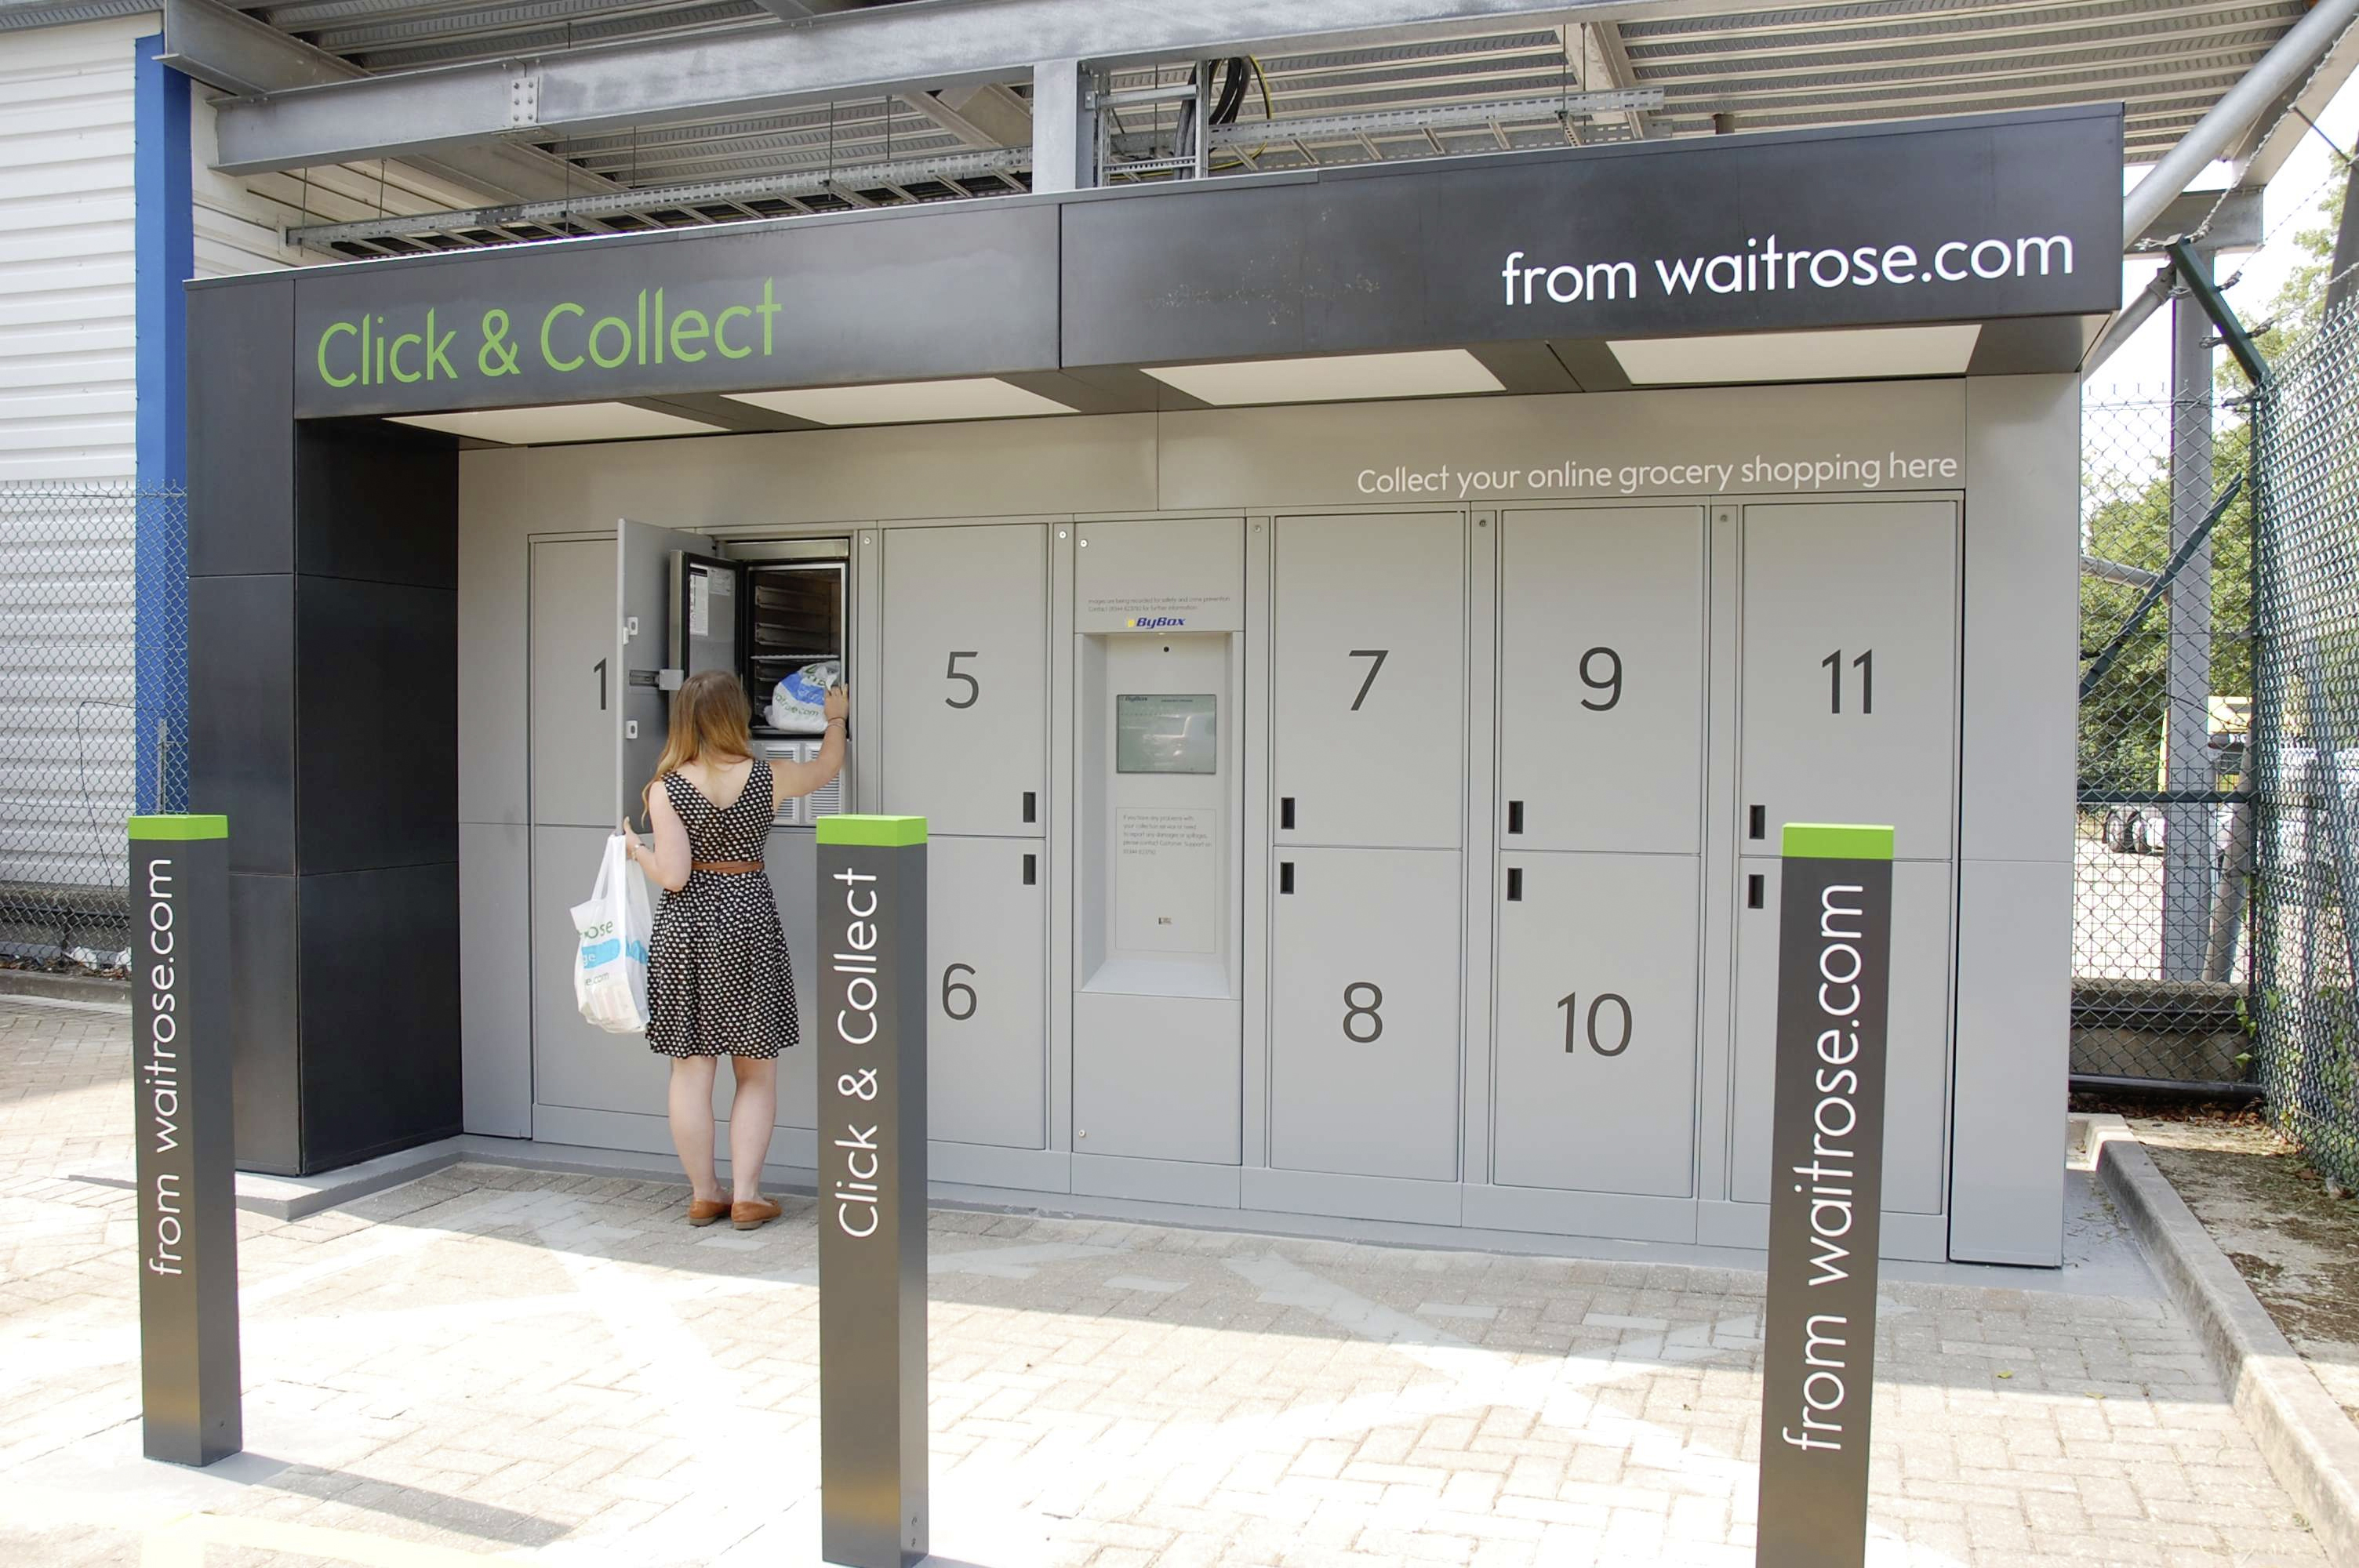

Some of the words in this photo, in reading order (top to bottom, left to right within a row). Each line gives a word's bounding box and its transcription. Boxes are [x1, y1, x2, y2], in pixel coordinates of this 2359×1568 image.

[1502, 251, 1637, 306] from
[1655, 234, 2073, 296] waitrose.com
[317, 307, 458, 388] Click
[478, 308, 521, 377] &
[540, 276, 783, 372] Collect
[1358, 464, 1449, 493] Collect
[1457, 470, 1520, 499] your
[1528, 461, 1612, 488] online
[1619, 463, 1733, 494] grocery
[1741, 454, 1881, 490] shopping
[1890, 452, 1957, 478] here
[1136, 617, 1186, 630] ByBox
[594, 658, 607, 710] 1
[945, 651, 980, 710] 5
[1348, 649, 1389, 711] 7
[1579, 646, 1623, 712] 9
[1822, 648, 1873, 714] 11
[833, 867, 878, 1044] Collect
[144, 859, 179, 1153] waitrose.com
[942, 963, 977, 1021] 6
[1343, 982, 1383, 1044] 8
[1557, 991, 1633, 1057] 10
[838, 1068, 878, 1101] &
[1792, 884, 1863, 1287] waitrose.com
[834, 1124, 878, 1237] Click
[148, 1174, 182, 1276] from
[1782, 1315, 1847, 1450] from
